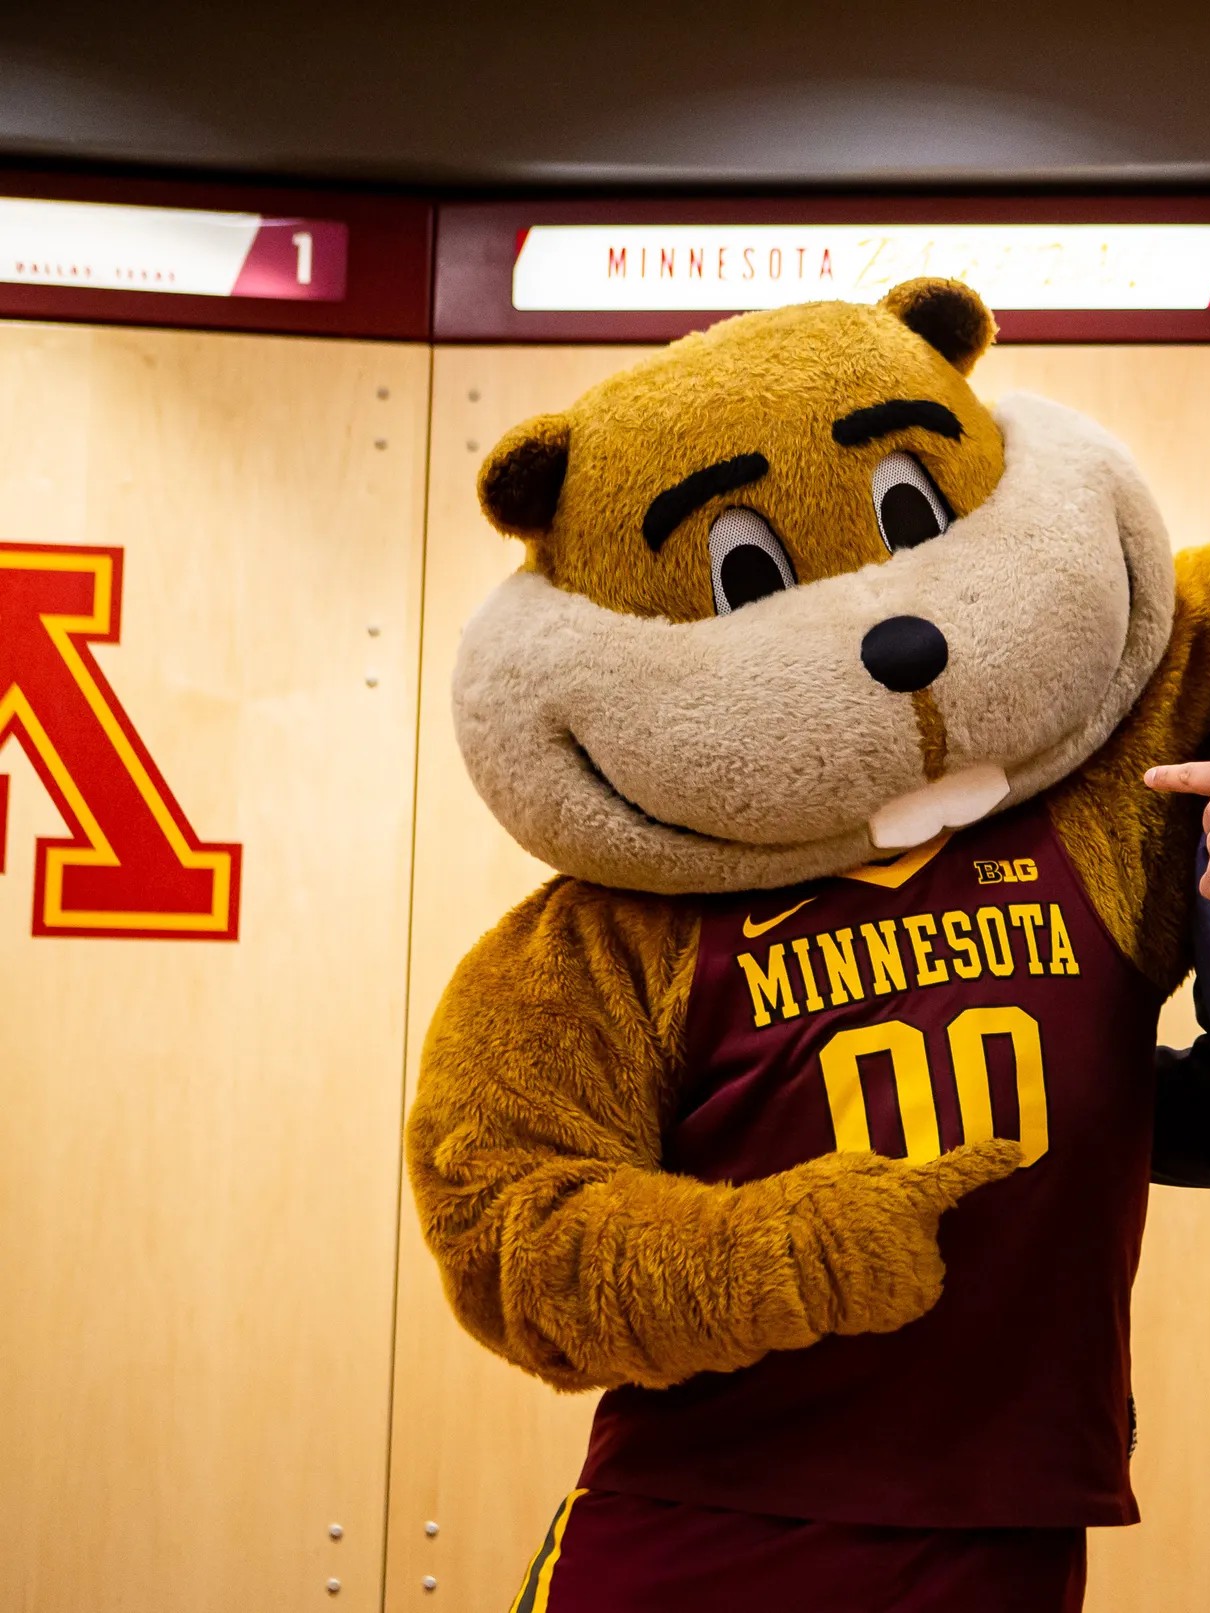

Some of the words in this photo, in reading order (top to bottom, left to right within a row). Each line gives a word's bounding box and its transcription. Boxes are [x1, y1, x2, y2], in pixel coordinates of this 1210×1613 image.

[292, 231, 312, 285] 1
[608, 247, 833, 280] MINNESOTA
[735, 902, 1081, 1029] MINNESOTA
[818, 1005, 1050, 1168] 00
